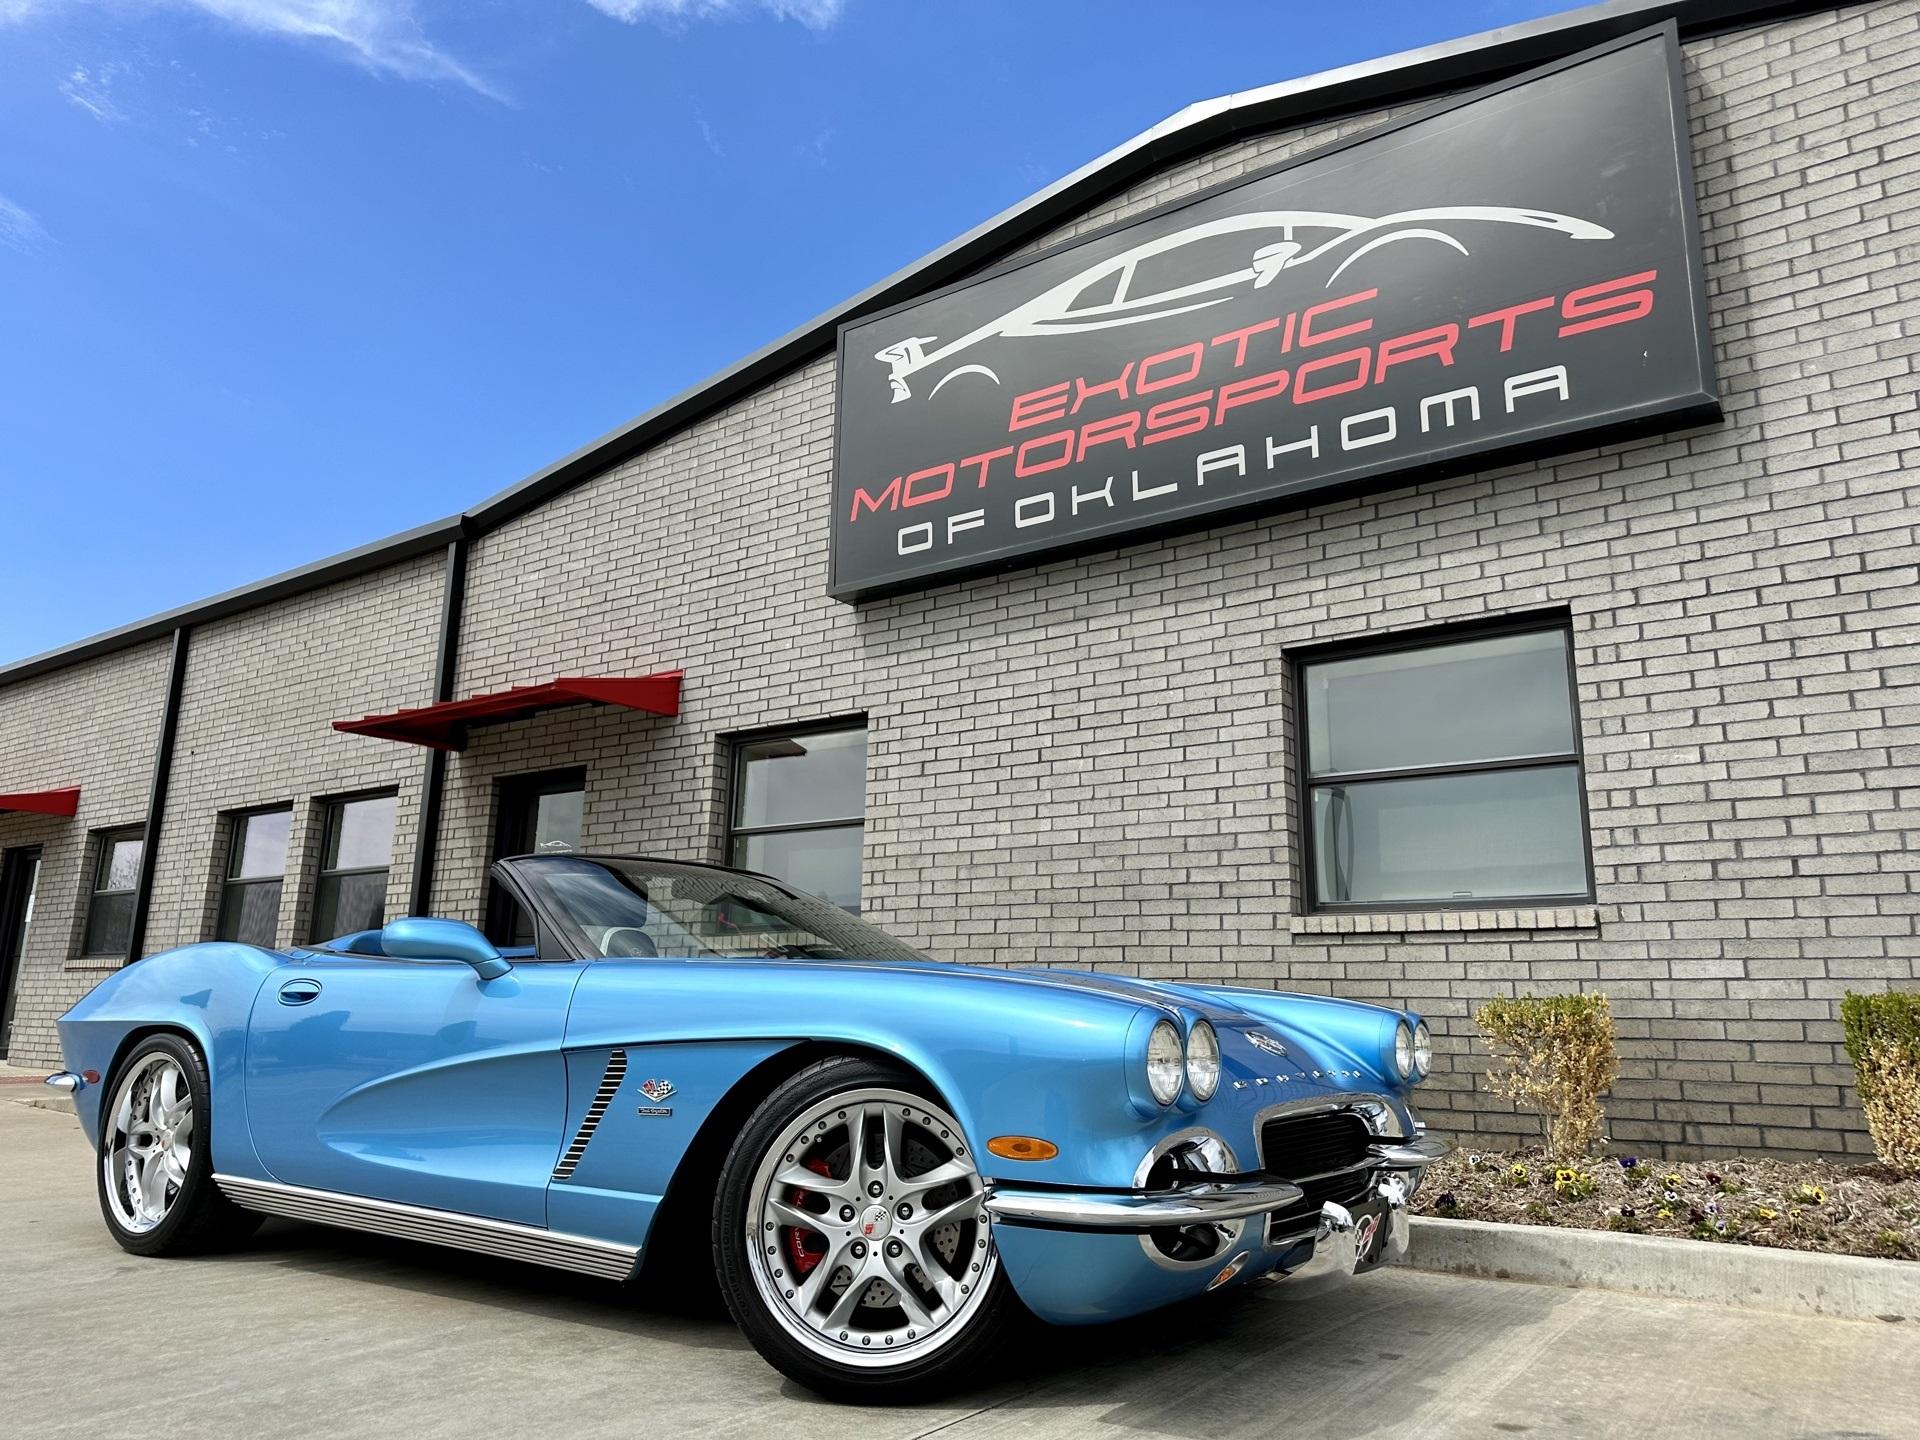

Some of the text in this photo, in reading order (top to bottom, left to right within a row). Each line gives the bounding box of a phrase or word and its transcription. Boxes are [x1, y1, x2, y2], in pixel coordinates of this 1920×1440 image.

[850, 269, 1657, 523] MOTORSPORTS
[1010, 289, 1377, 431] EXOTIC
[897, 364, 1570, 556] OF OKLAHOMA
